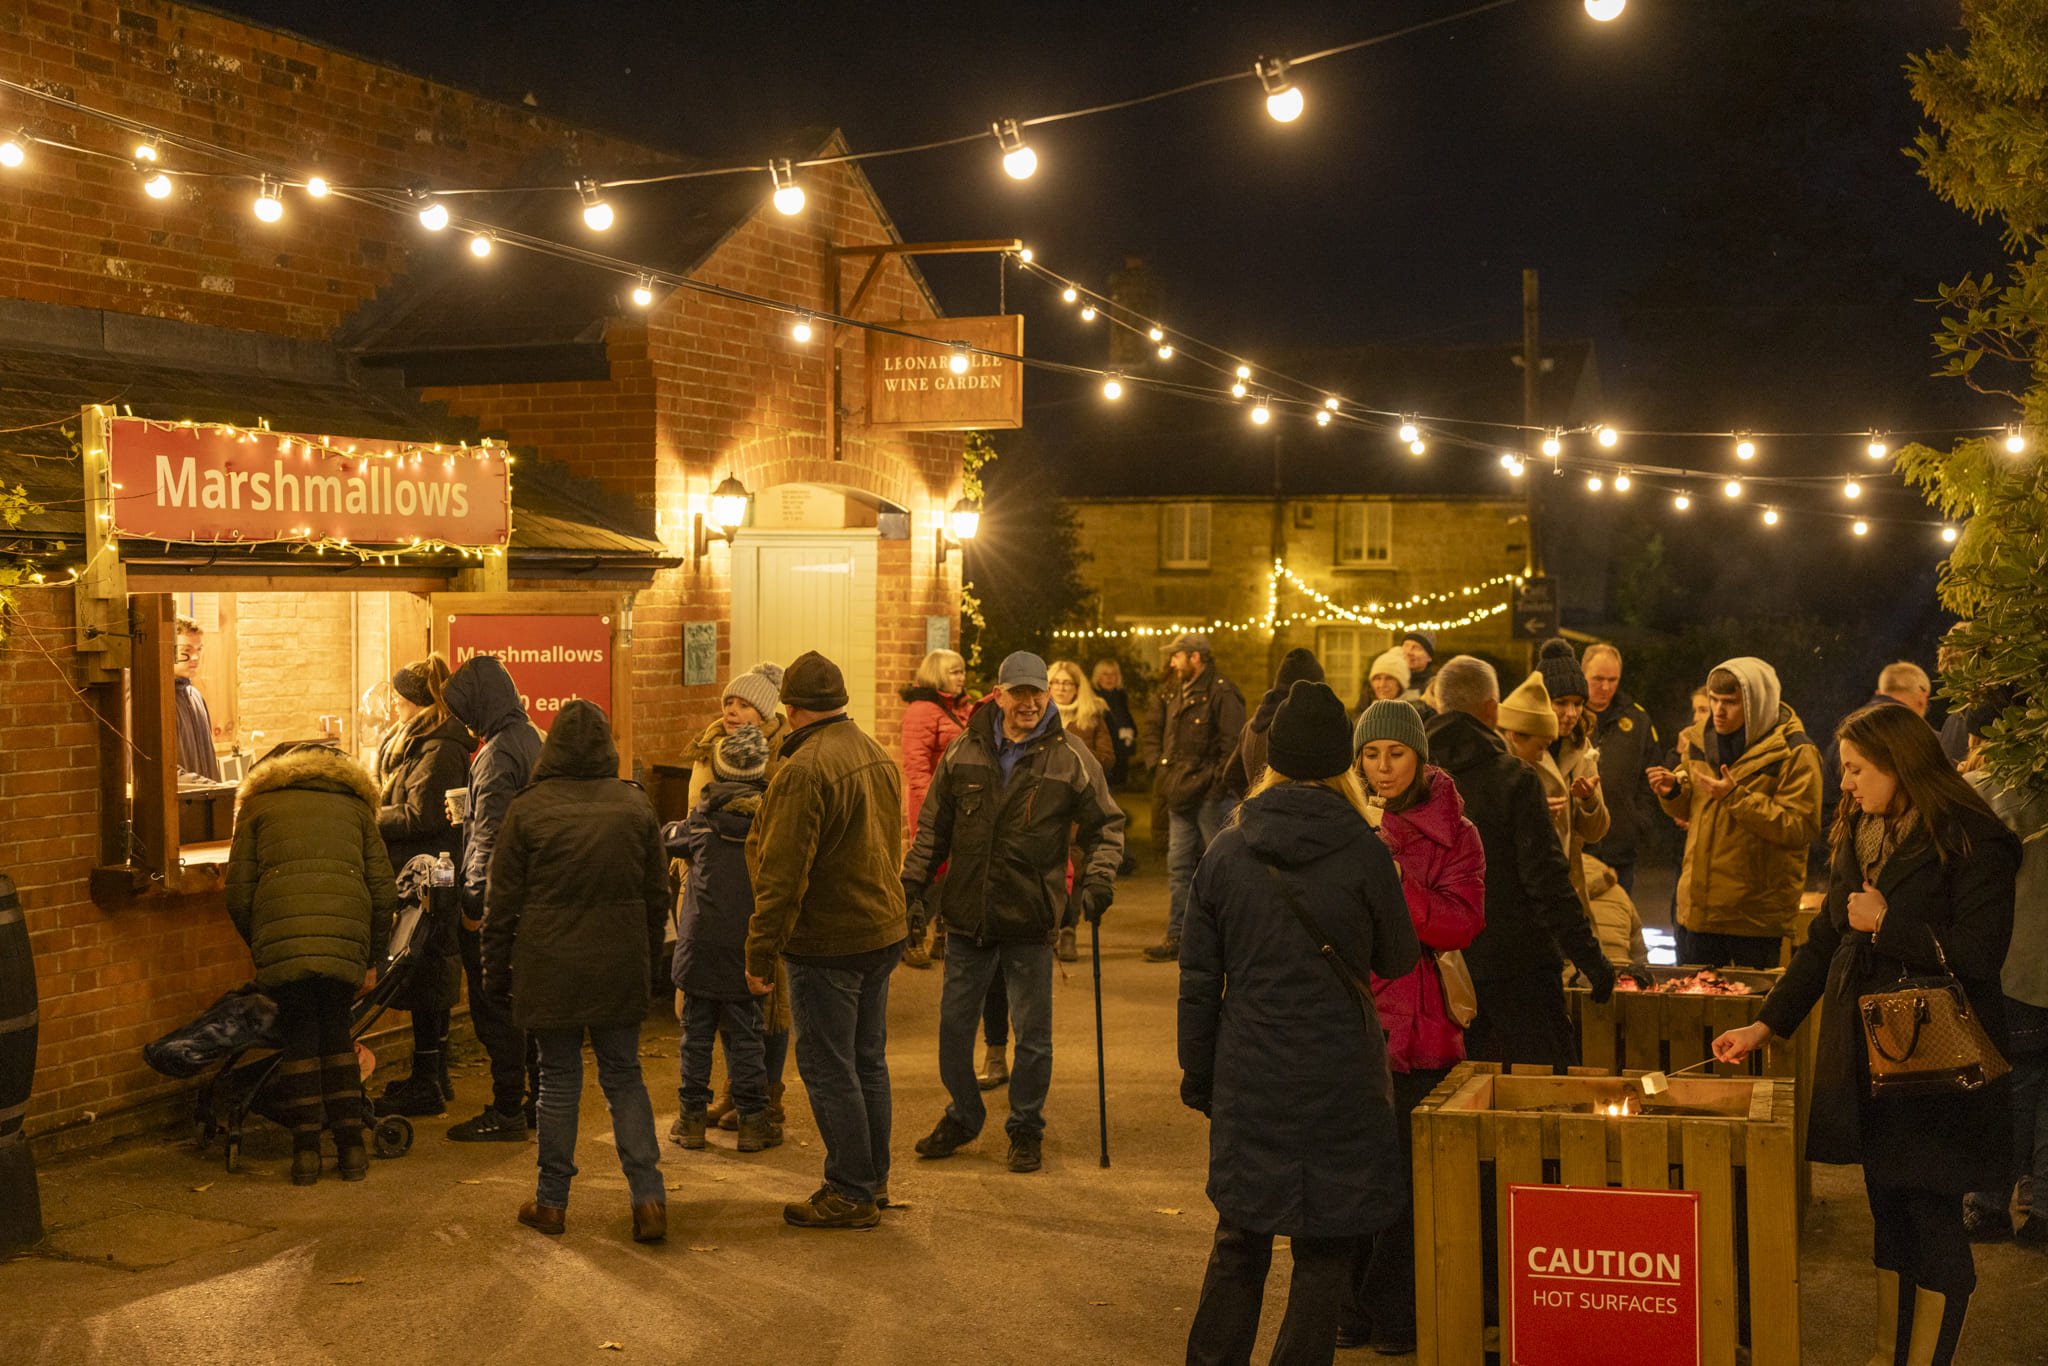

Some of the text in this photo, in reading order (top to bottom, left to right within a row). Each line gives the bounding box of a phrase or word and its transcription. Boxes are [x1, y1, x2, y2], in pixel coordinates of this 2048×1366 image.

[885, 354, 1002, 371] LEONARLEE
[885, 375, 1003, 392] WINE GARDEN
[155, 455, 469, 517] Marshmallows
[1528, 1246, 1680, 1279] CAUTION
[1533, 1290, 1677, 1314] HOT SURFACES
